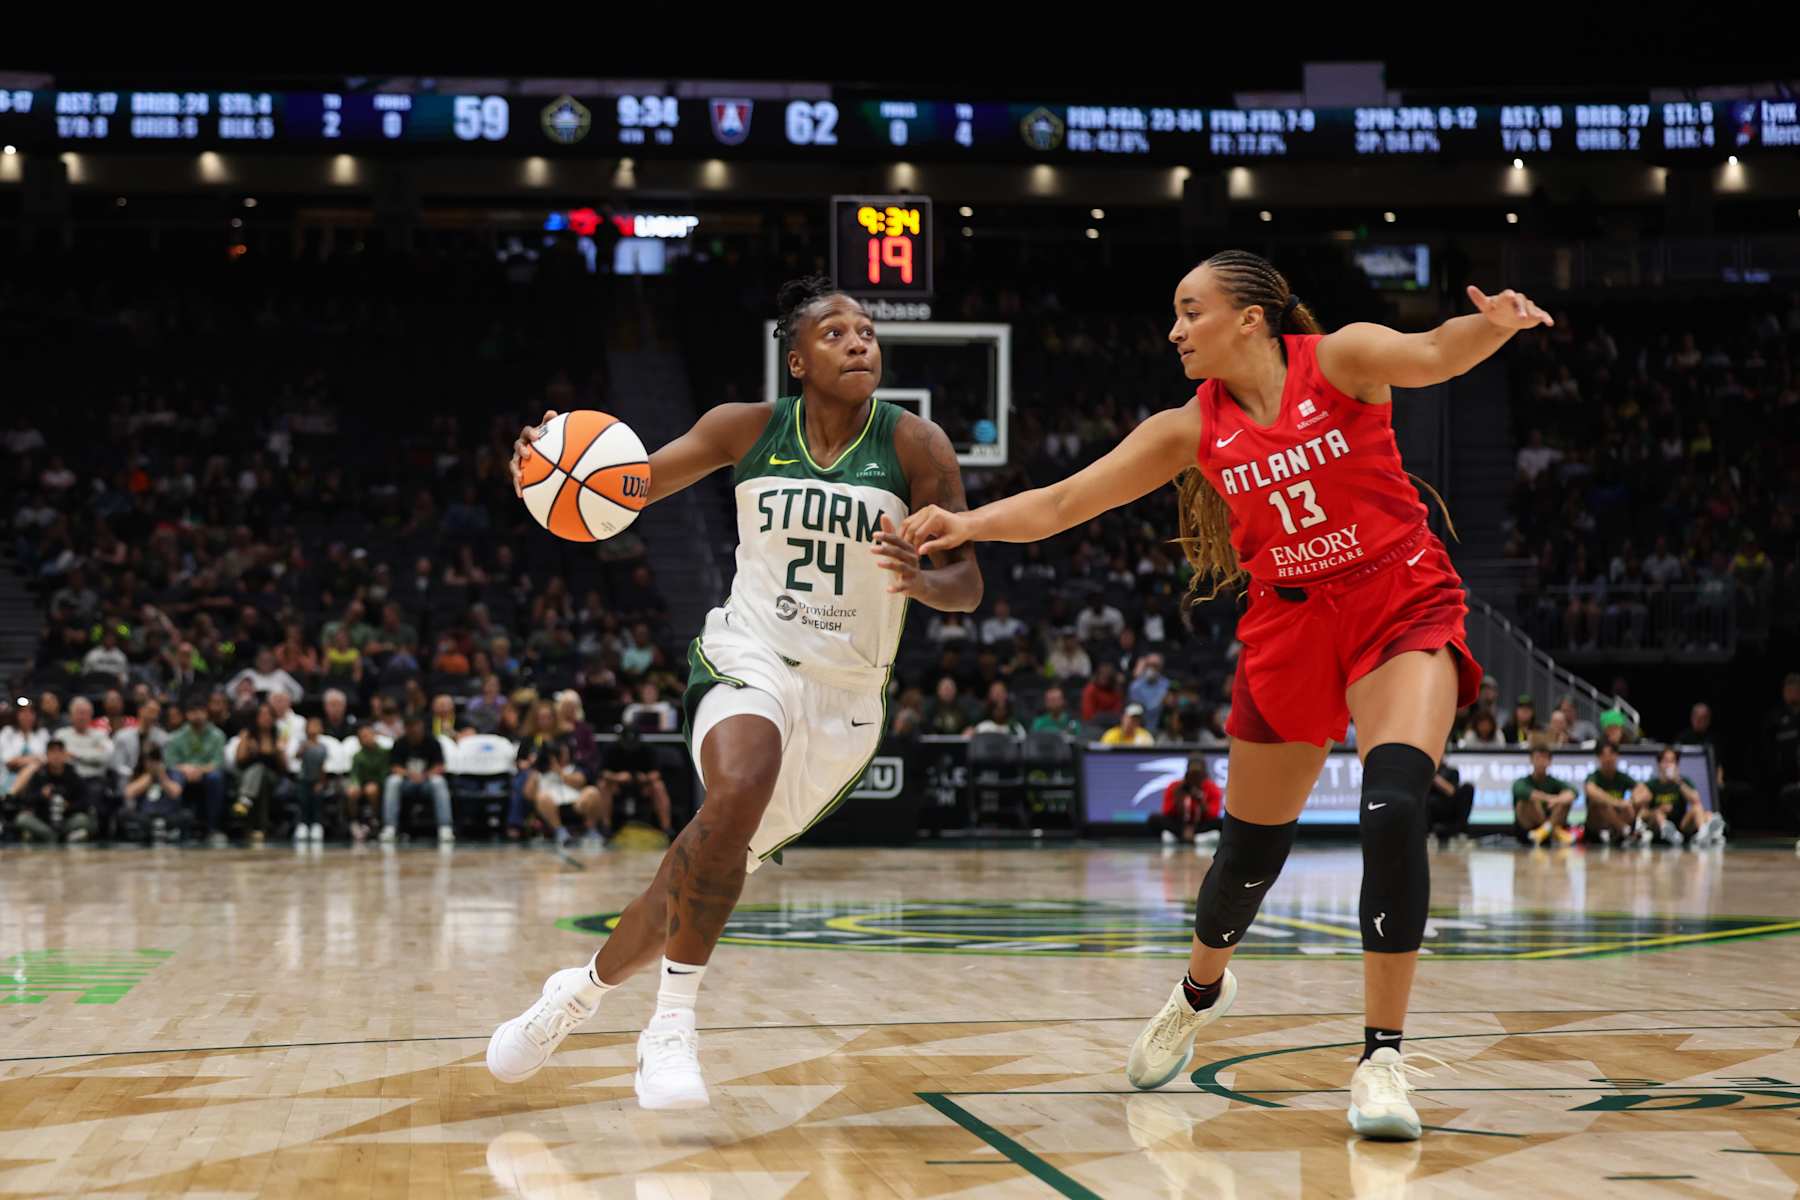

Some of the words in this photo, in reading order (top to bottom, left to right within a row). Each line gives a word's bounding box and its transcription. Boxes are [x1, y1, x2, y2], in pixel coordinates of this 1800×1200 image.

[322, 111, 342, 138] 2
[453, 95, 509, 140] 59
[786, 101, 839, 145] 62
[858, 206, 920, 236] 9:34
[868, 236, 912, 284] 19
[1221, 428, 1350, 495] ATLANTA
[758, 488, 887, 545] STORM
[1268, 480, 1327, 535] 13
[786, 537, 845, 596] 24
[1270, 524, 1361, 566] EMORY
[1278, 547, 1364, 577] HEALTHCARE
[800, 602, 857, 618] Providence
[801, 615, 842, 631] SWEDISH
